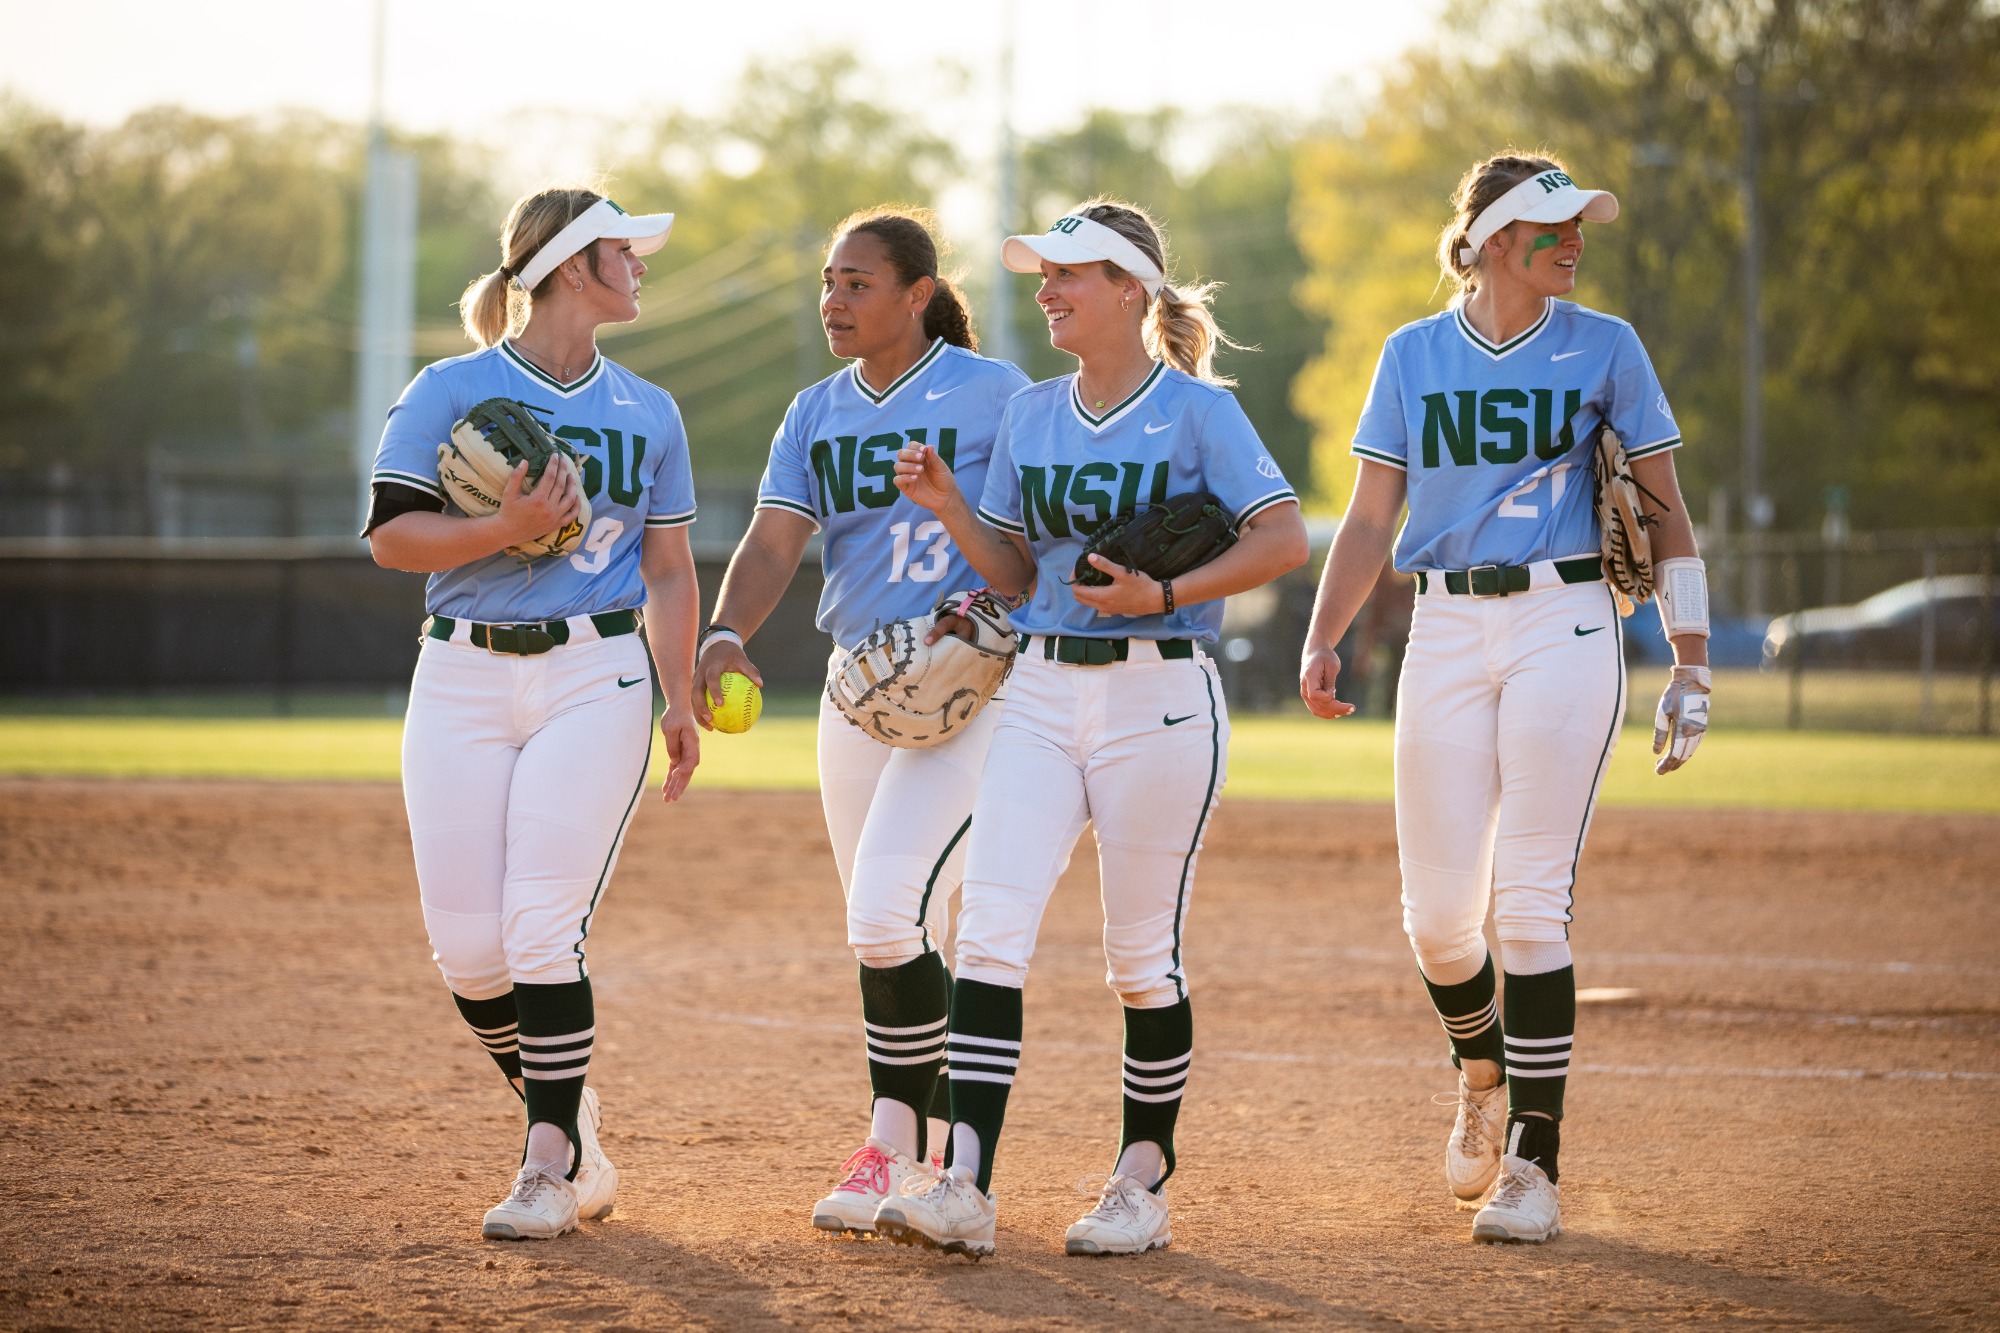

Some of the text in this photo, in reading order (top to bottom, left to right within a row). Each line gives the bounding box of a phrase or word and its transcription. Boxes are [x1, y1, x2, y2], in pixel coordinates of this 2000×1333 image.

[1421, 389, 1581, 469] NSU
[461, 483, 502, 509] MIZUN
[569, 516, 624, 575] 9
[886, 520, 950, 583] 13
